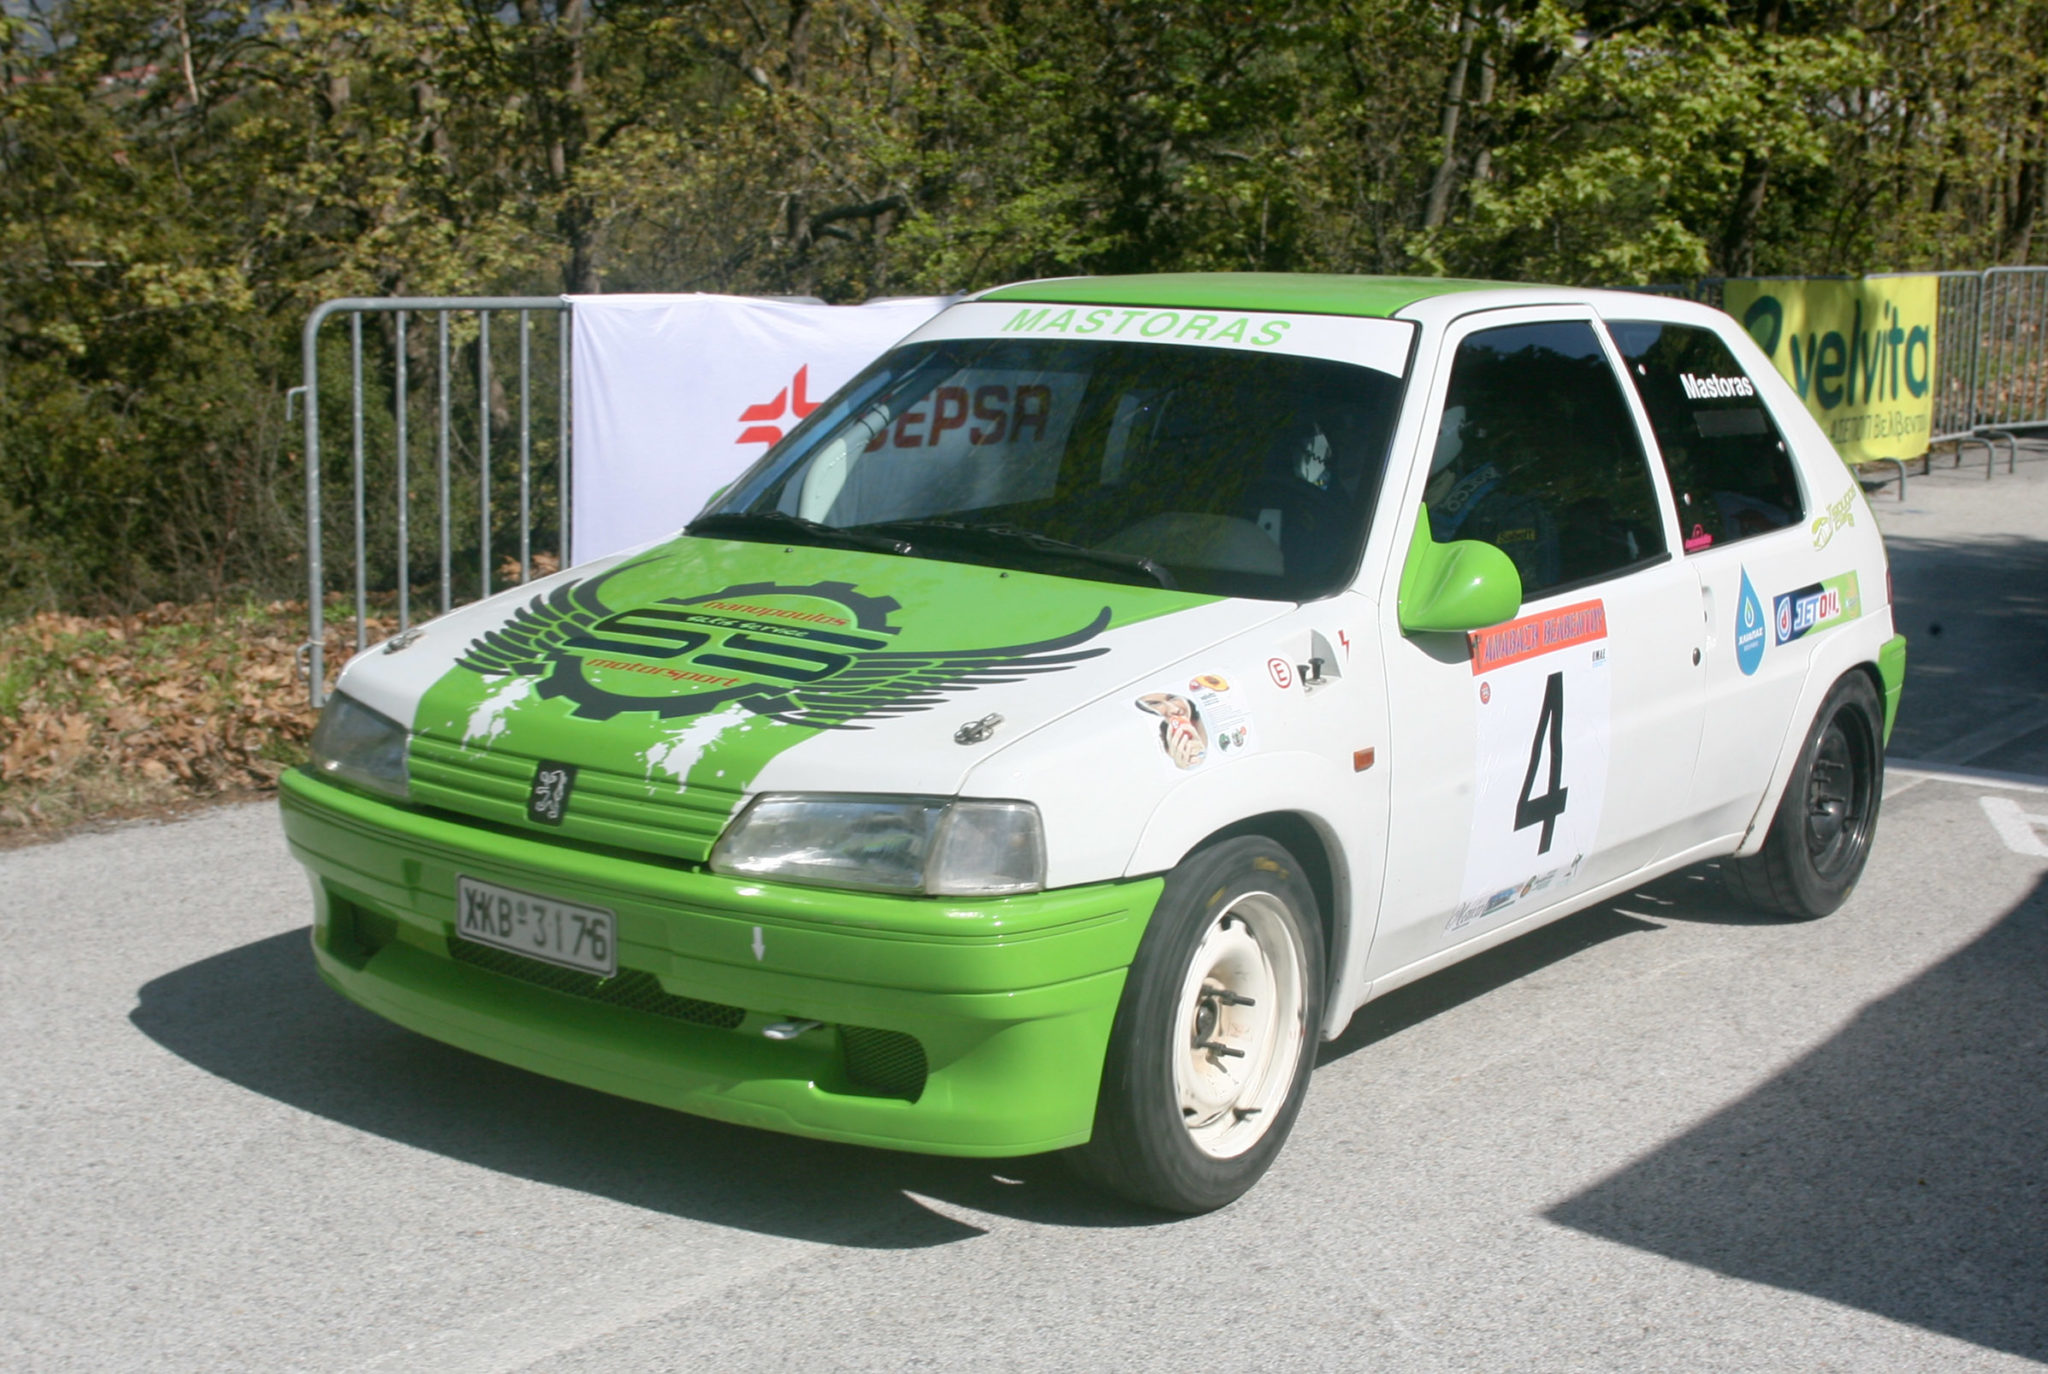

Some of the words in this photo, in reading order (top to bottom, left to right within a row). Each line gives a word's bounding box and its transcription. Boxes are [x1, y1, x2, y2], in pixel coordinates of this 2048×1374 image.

[1001, 307, 1292, 347] MASTORAS
[1790, 299, 1930, 411] velvita
[1680, 373, 1754, 400] Mastoras
[585, 657, 741, 688] motorsport
[1513, 670, 1569, 856] 4
